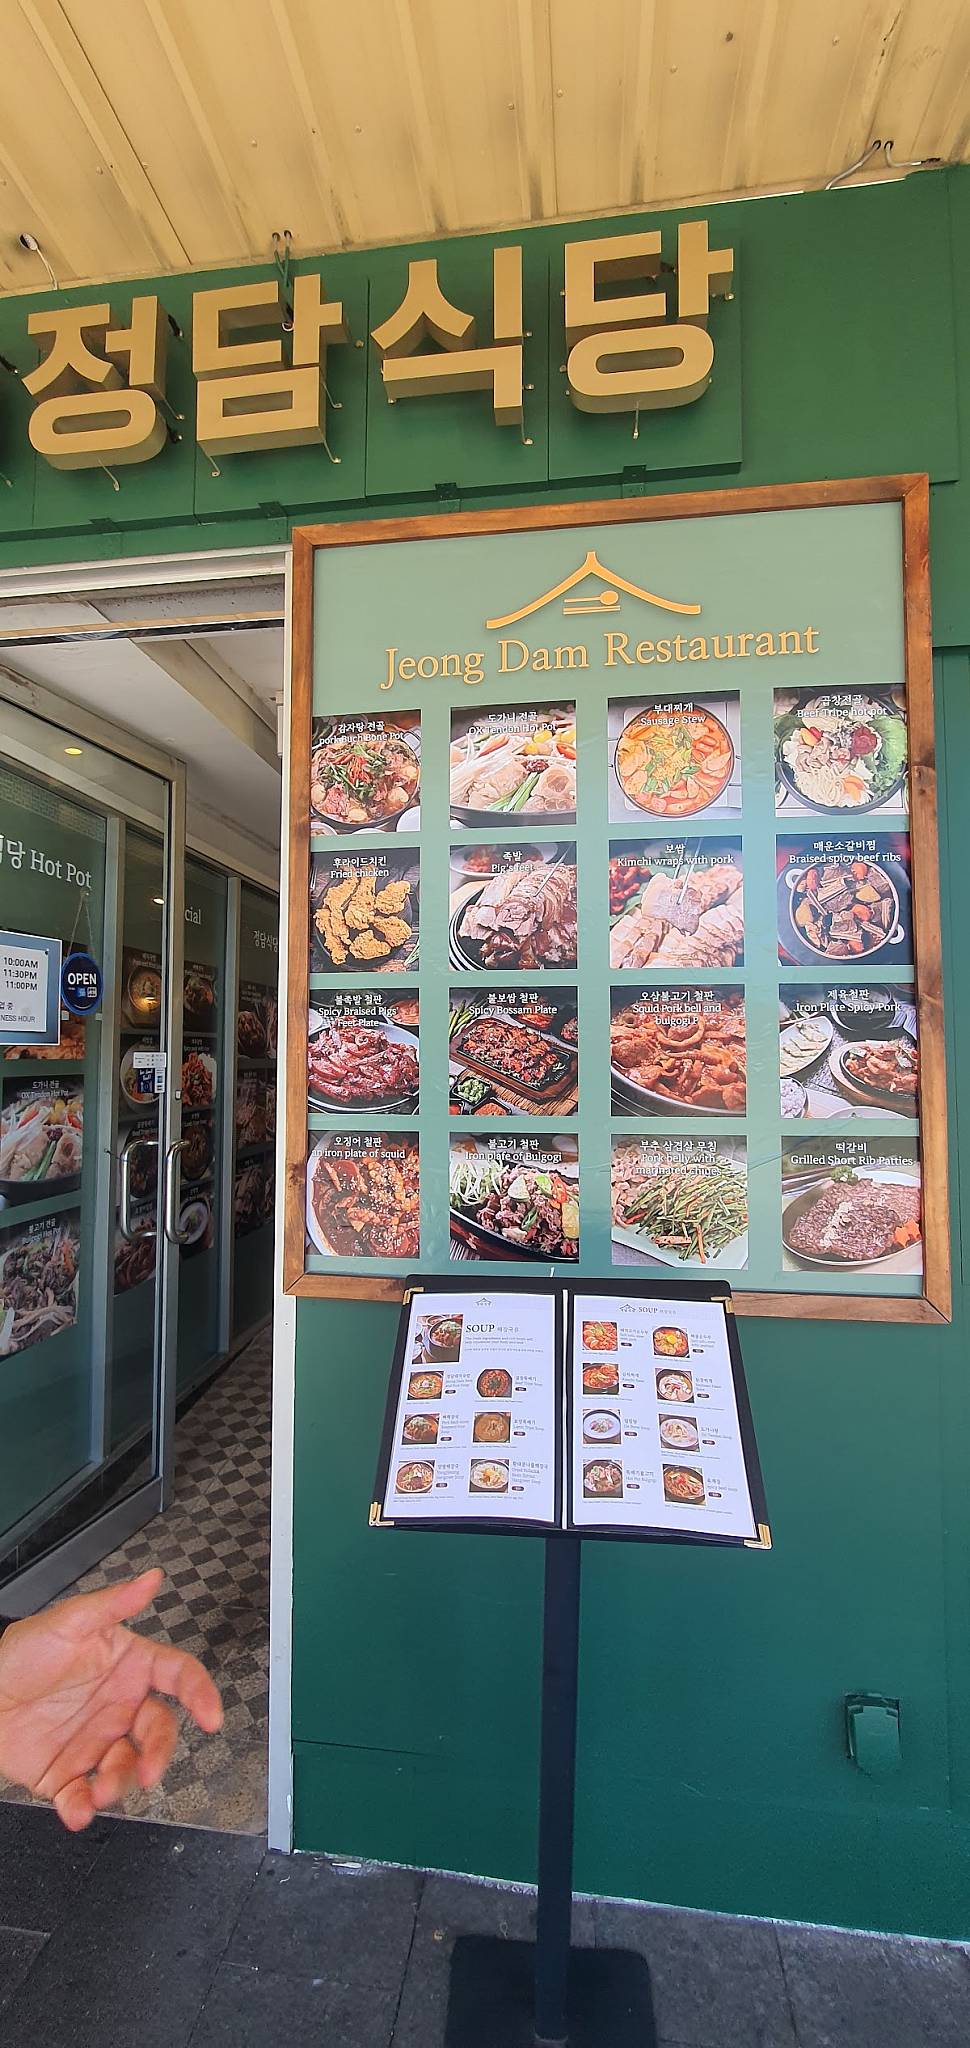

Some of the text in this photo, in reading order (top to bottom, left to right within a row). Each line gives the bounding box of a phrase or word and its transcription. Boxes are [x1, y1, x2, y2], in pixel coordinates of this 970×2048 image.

[21, 220, 735, 468] 정담식당
[380, 626, 820, 690] Jeong Dam Restaurant
[820, 694, 863, 706] 곱창전골
[653, 702, 694, 714] 부대찌개
[797, 706, 888, 718] Beef Tripe hot pot
[488, 711, 538, 723] 도가니 전골
[640, 715, 707, 727] Sausage Stew
[338, 720, 385, 734] 감자탕 전골
[468, 722, 558, 736] OX Tendon Hot Pot
[365, 733, 388, 742] Bone
[389, 732, 405, 741] Pot
[665, 843, 686, 855] 보쌈
[813, 839, 876, 852] 매운소갈비찜
[333, 855, 387, 868] 후라이드치킨
[502, 850, 523, 862] 족발
[617, 854, 735, 868] Kimchi wraps with pork
[789, 852, 901, 865] Braised spicy beef ribs
[30, 848, 63, 879] Hot
[66, 862, 92, 889] Pot
[330, 868, 389, 879] Fried chicken
[491, 862, 534, 875] Pig's feet
[3, 956, 39, 969] 10:00AM
[3, 968, 37, 980] 11:30PM
[67, 972, 97, 985] OPEN
[5, 980, 38, 991] 11:00PM
[335, 994, 383, 1006] 불족발 철판
[487, 992, 539, 1004] 불보쌈 철판
[639, 990, 715, 1002] 오삼불고기 철판
[827, 988, 871, 1001] 제육철판
[318, 1006, 399, 1018] Spicy Braised Pigs'
[468, 1005, 558, 1016] Spicy Bossam Plate
[632, 1002, 722, 1015] Squid Pork bell and
[795, 1002, 901, 1014] Iron Plate Spicy Pork
[18, 1015, 36, 1023] HOUR
[338, 1018, 380, 1027] Feet Plate
[655, 1015, 692, 1027] bulgogi
[333, 1136, 383, 1148] 오징어 철판
[488, 1138, 540, 1150] 불고기 철판
[640, 1140, 718, 1153] 부추 삼겹살 무침
[835, 1142, 868, 1154] 떡갈비
[311, 1148, 406, 1160] an iron plate of squid
[465, 1151, 485, 1161] Iron
[512, 1151, 524, 1161] of
[526, 1151, 563, 1164] Bulgogi
[641, 1152, 716, 1165] Pork belly with
[790, 1154, 914, 1166] Grilled Short Rib Patties
[638, 1306, 658, 1314] SOUP
[465, 1324, 495, 1333] SOUP
